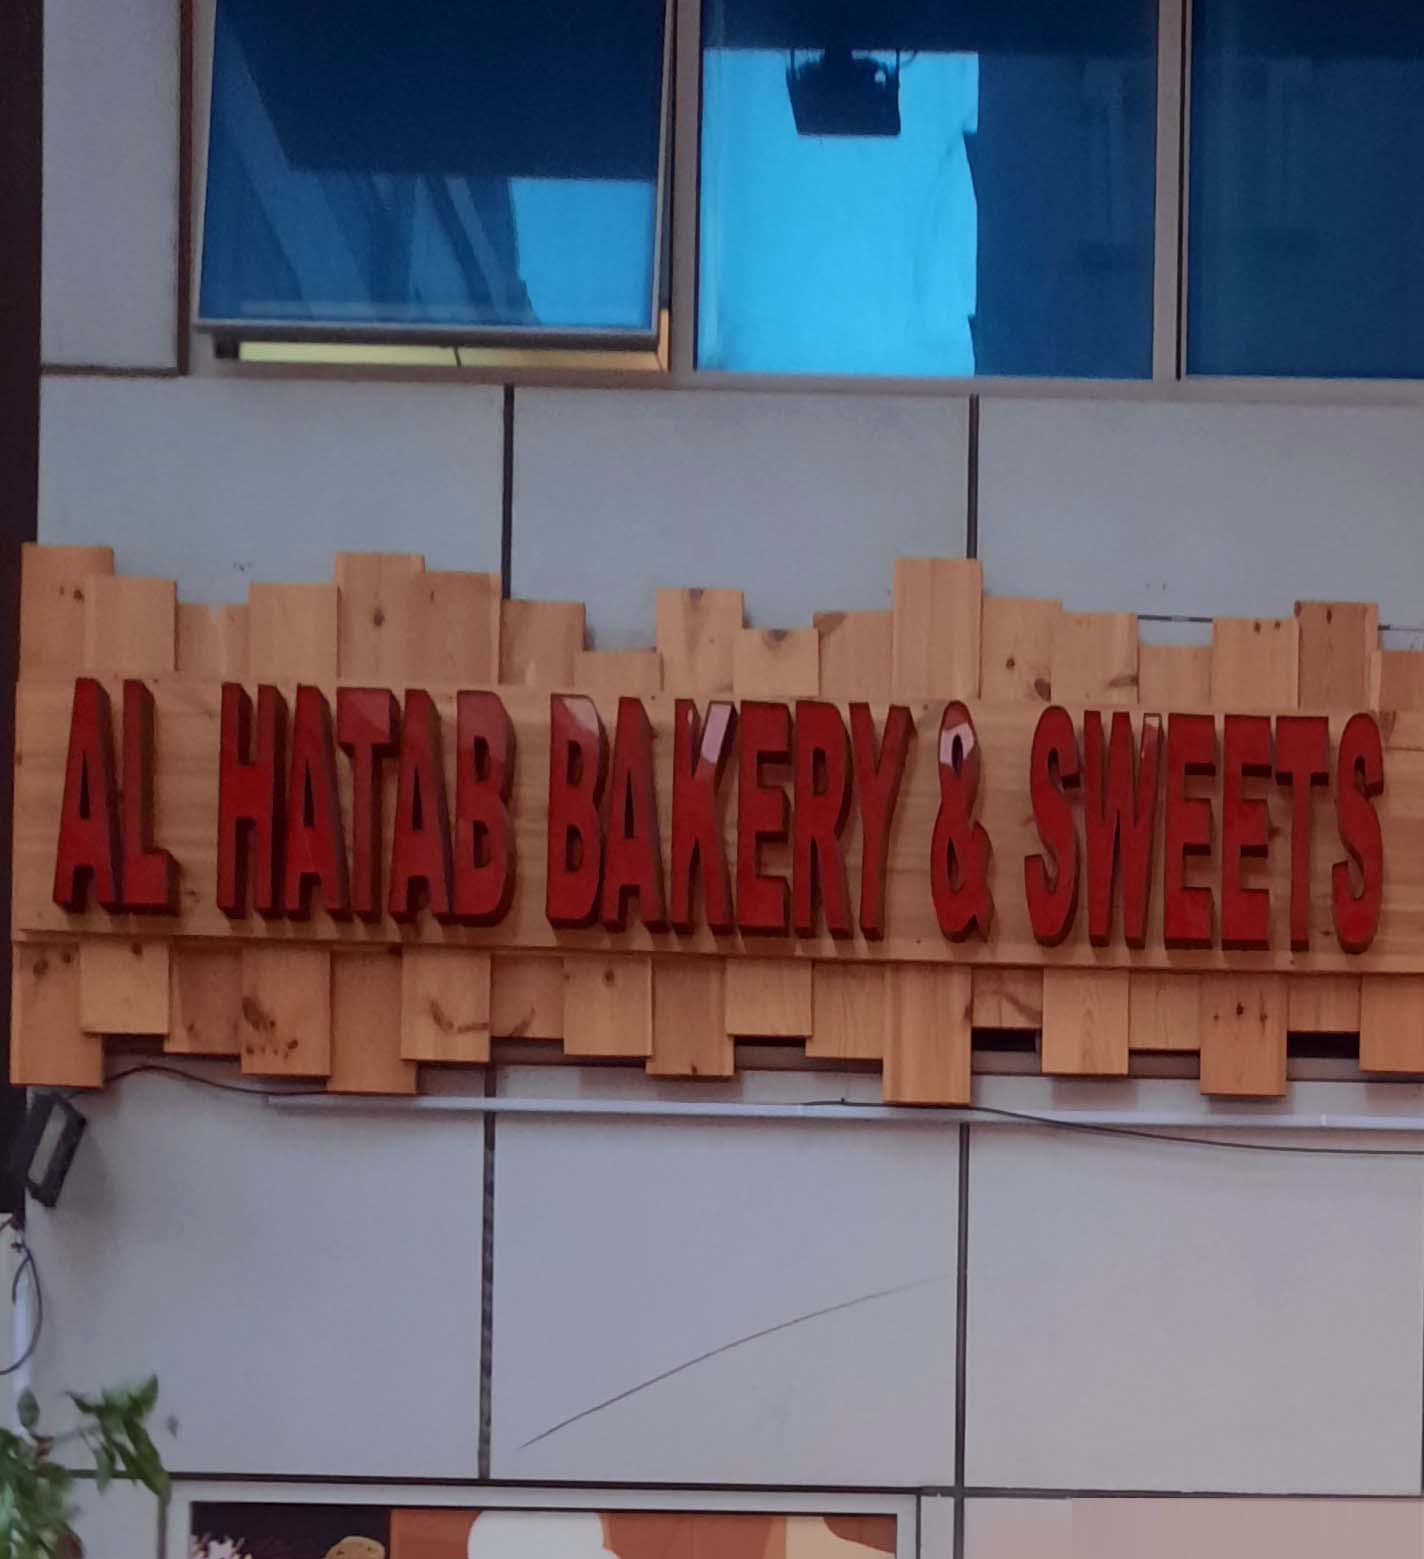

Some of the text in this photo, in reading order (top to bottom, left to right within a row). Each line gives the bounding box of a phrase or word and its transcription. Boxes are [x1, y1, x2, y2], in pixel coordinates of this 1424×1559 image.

[53, 678, 1386, 954] AL HATAB BAKERY & SWEETS
